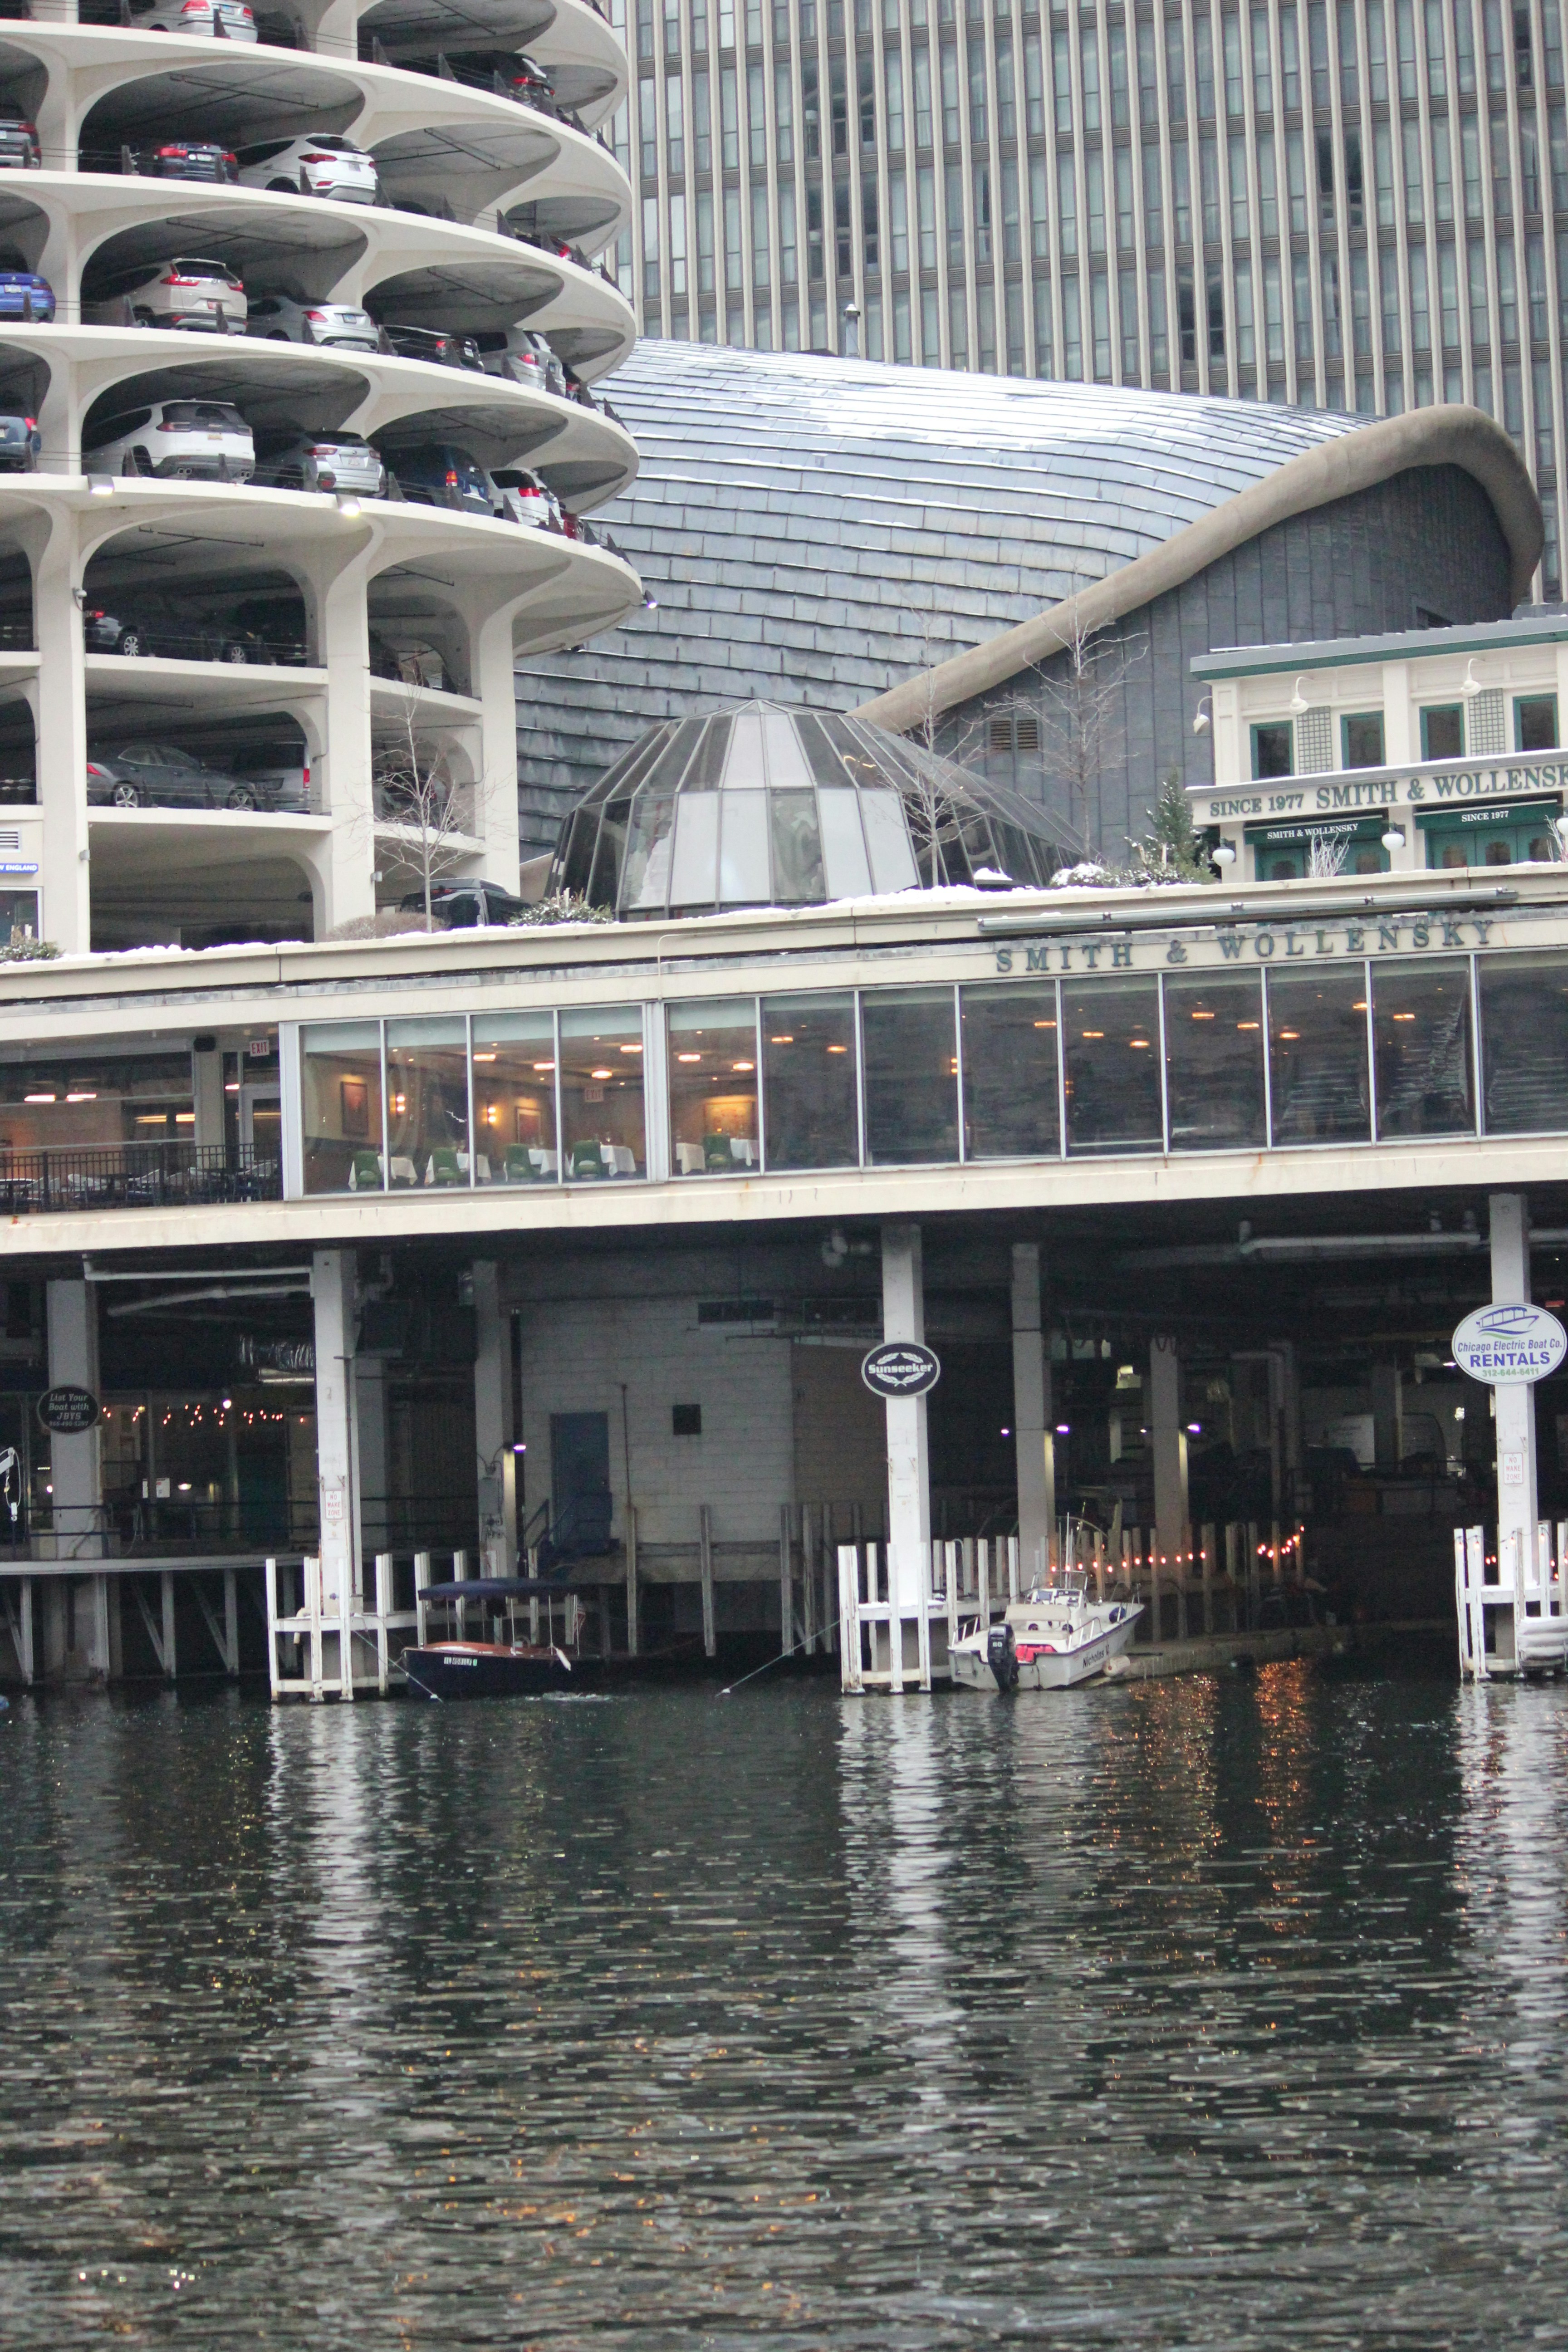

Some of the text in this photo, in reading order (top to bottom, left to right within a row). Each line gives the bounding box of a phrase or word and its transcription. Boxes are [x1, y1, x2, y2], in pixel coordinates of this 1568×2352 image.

[1210, 798, 1262, 817] SINCE
[1269, 794, 1304, 812] 1977
[1317, 780, 1398, 809] SMITH
[1407, 778, 1425, 800] &
[1461, 810, 1509, 823] SINCE 1977
[1267, 823, 1359, 839] SMITH & WOLLENSKY
[996, 919, 1494, 972] SMITH & WOLLENSKY
[252, 1042, 267, 1054] EXIT
[1457, 1338, 1563, 1353] Chicago Electric Boat Co.
[1470, 1351, 1550, 1368] RENTALS
[868, 1363, 933, 1374] Sunseeker
[49, 1393, 88, 1401] List Your
[48, 1402, 90, 1411] Boat with
[56, 1412, 82, 1420] JBYS
